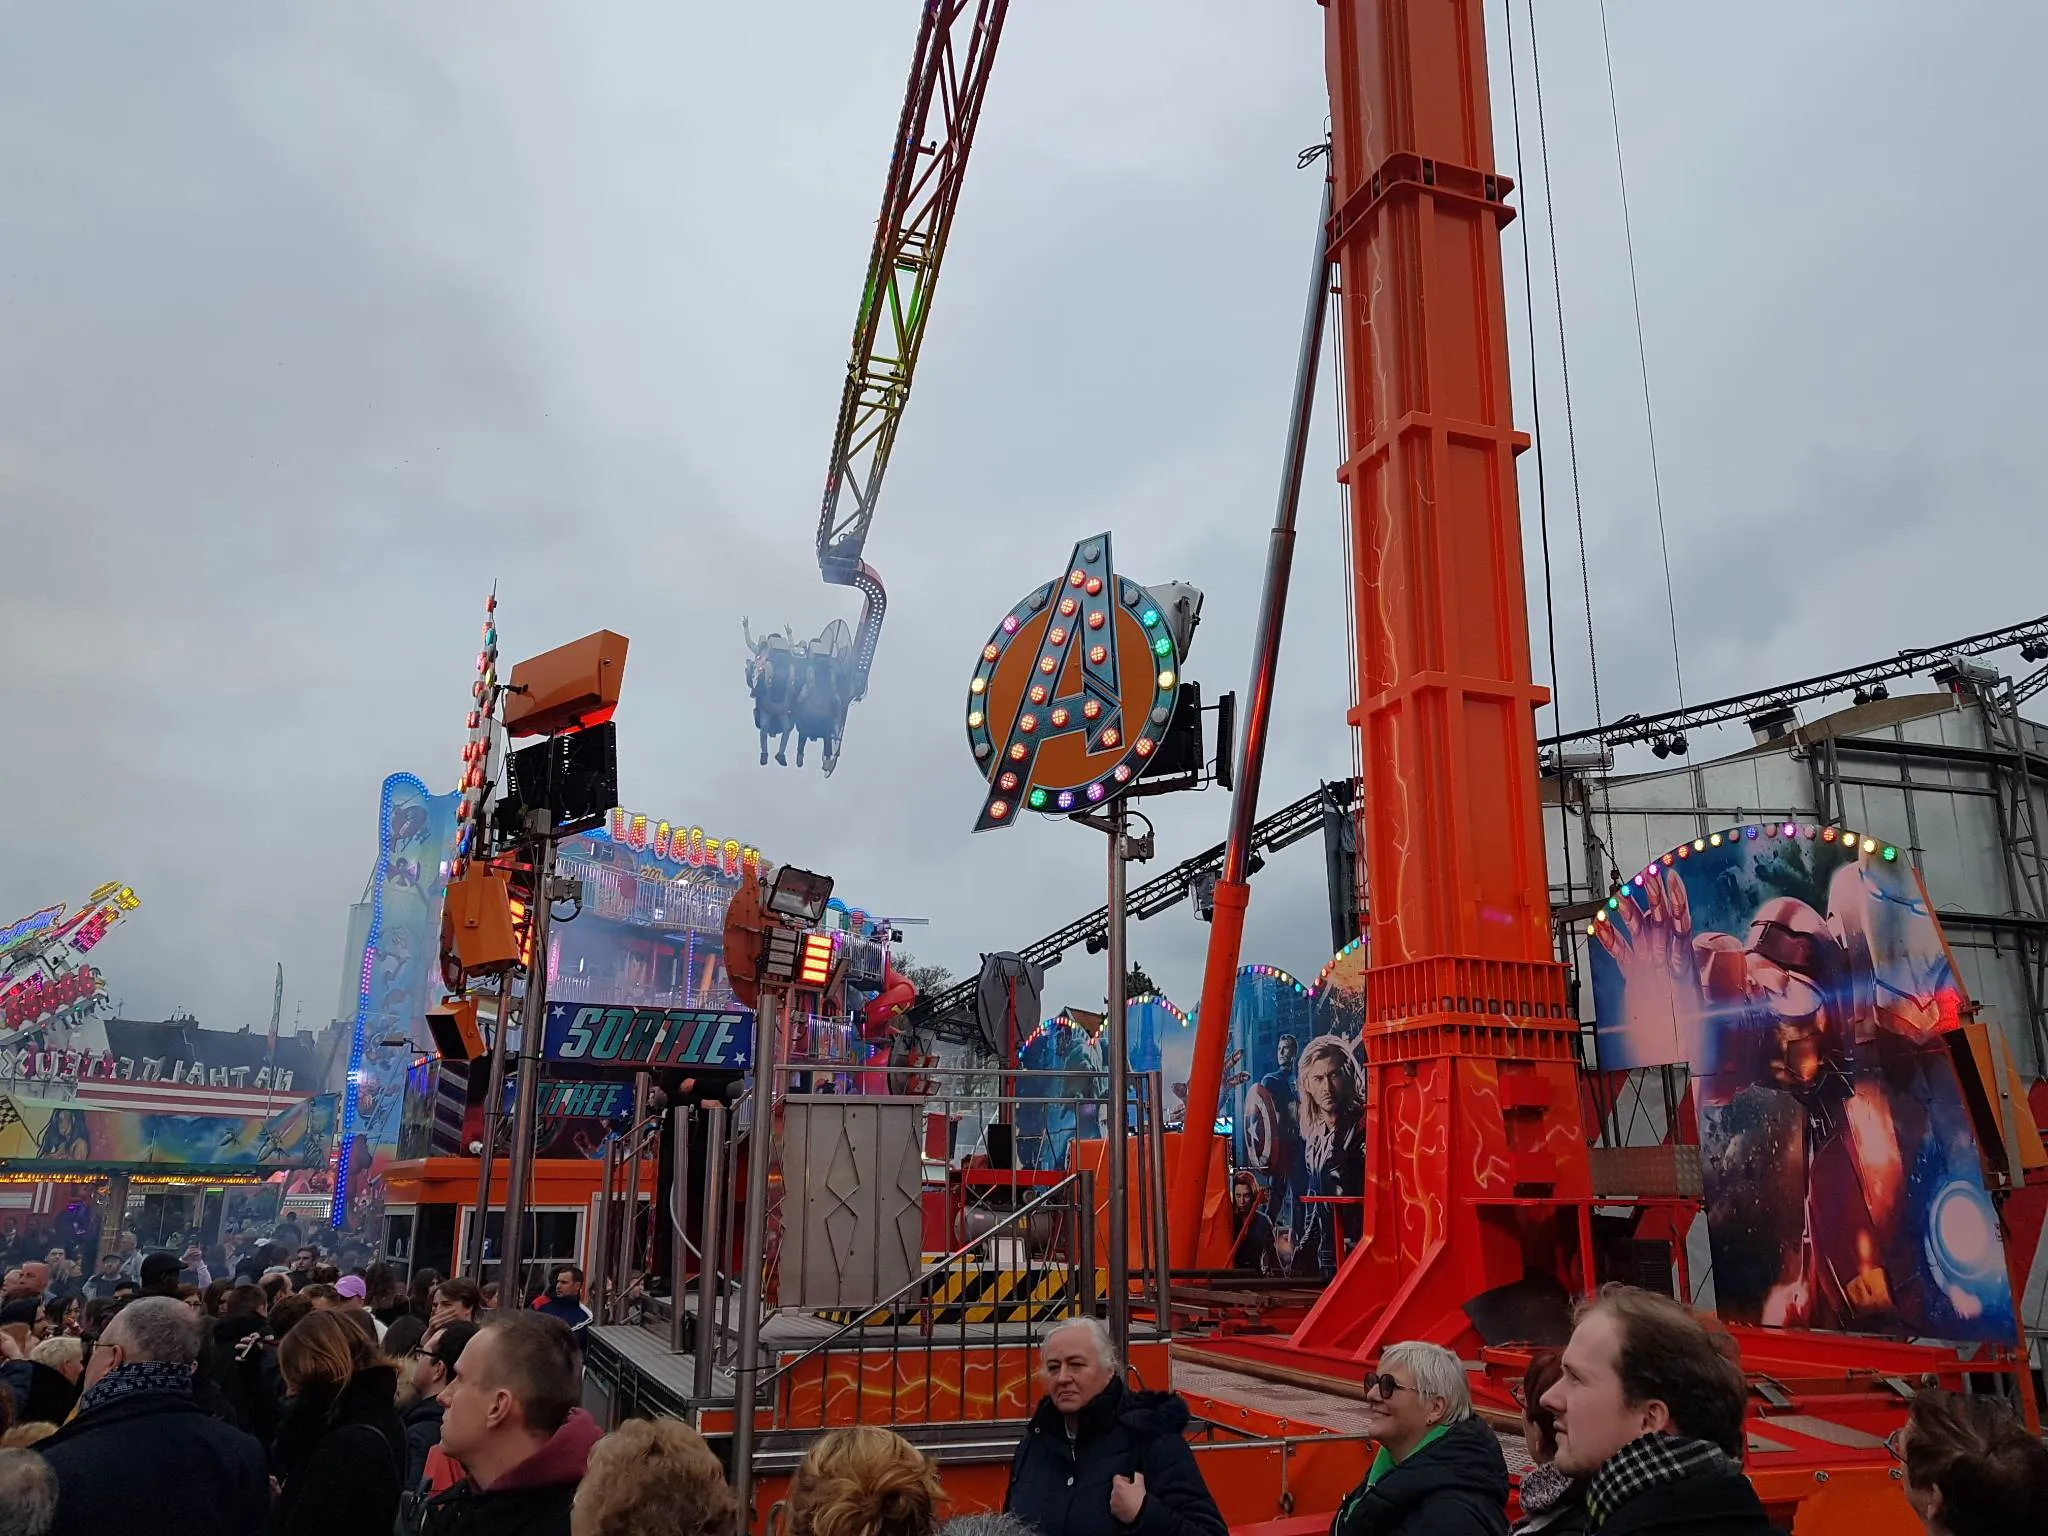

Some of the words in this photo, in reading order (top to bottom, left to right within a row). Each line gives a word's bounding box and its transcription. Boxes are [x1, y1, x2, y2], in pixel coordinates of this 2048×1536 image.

[611, 806, 647, 851] LA
[654, 819, 764, 880] CASERN
[558, 1007, 743, 1065] SORTIE
[511, 1081, 626, 1118] NTREE
